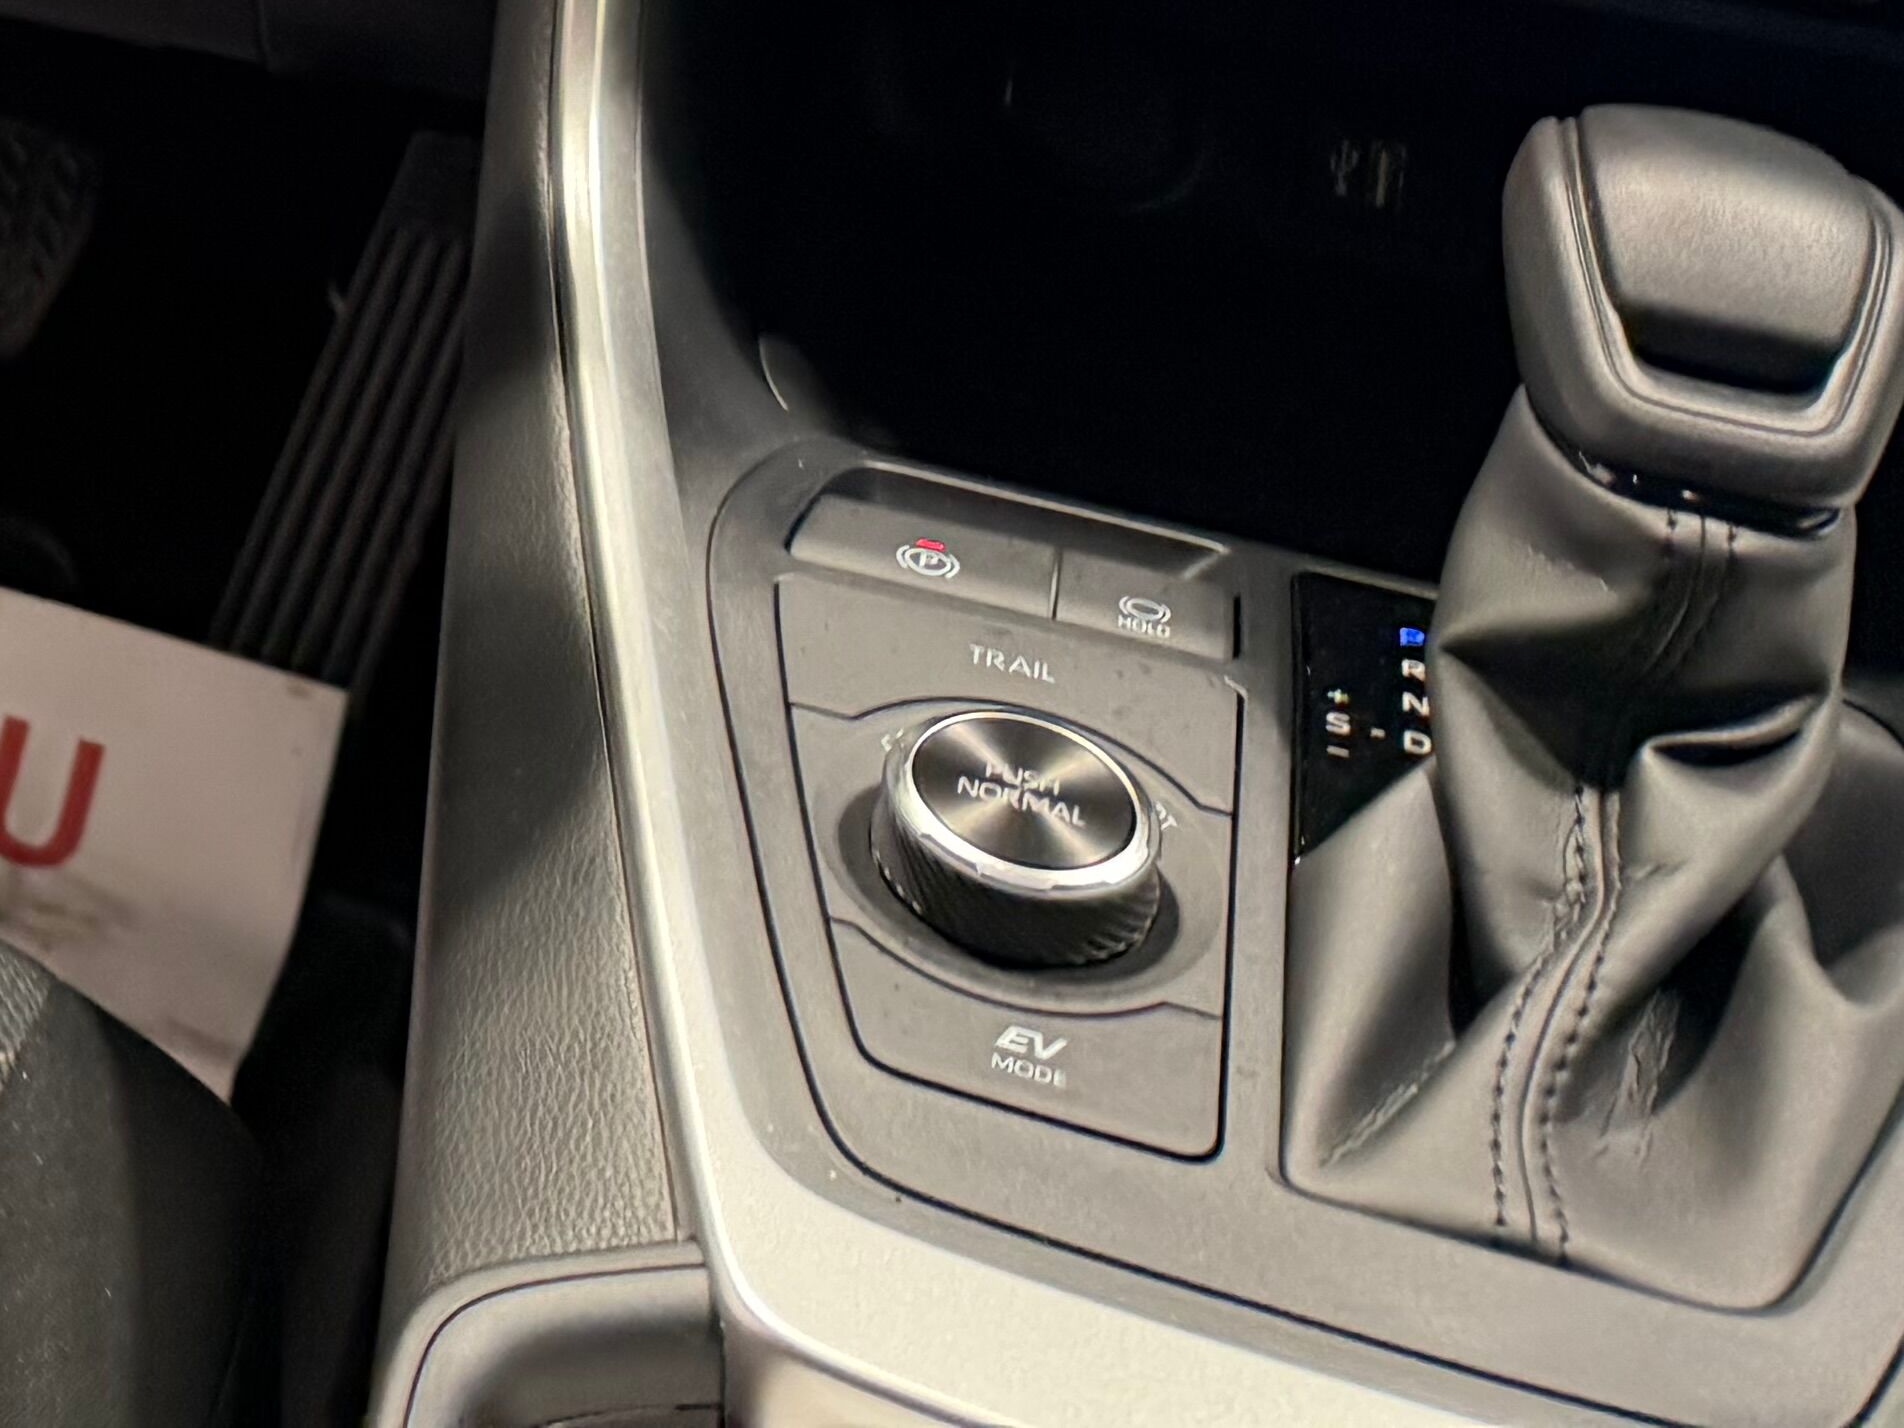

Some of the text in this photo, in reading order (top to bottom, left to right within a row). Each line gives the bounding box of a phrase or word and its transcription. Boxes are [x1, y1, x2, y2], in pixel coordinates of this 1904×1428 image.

[1117, 614, 1172, 639] HOLD
[968, 643, 1057, 685] TRAIL
[1401, 657, 1427, 683] R
[1402, 691, 1430, 717] N
[1325, 711, 1351, 736] S
[1403, 729, 1432, 756] D
[985, 760, 1061, 796] PUSH
[956, 774, 1086, 828] NORMAL
[994, 1025, 1070, 1060] EV
[991, 1051, 1067, 1089] MODE
